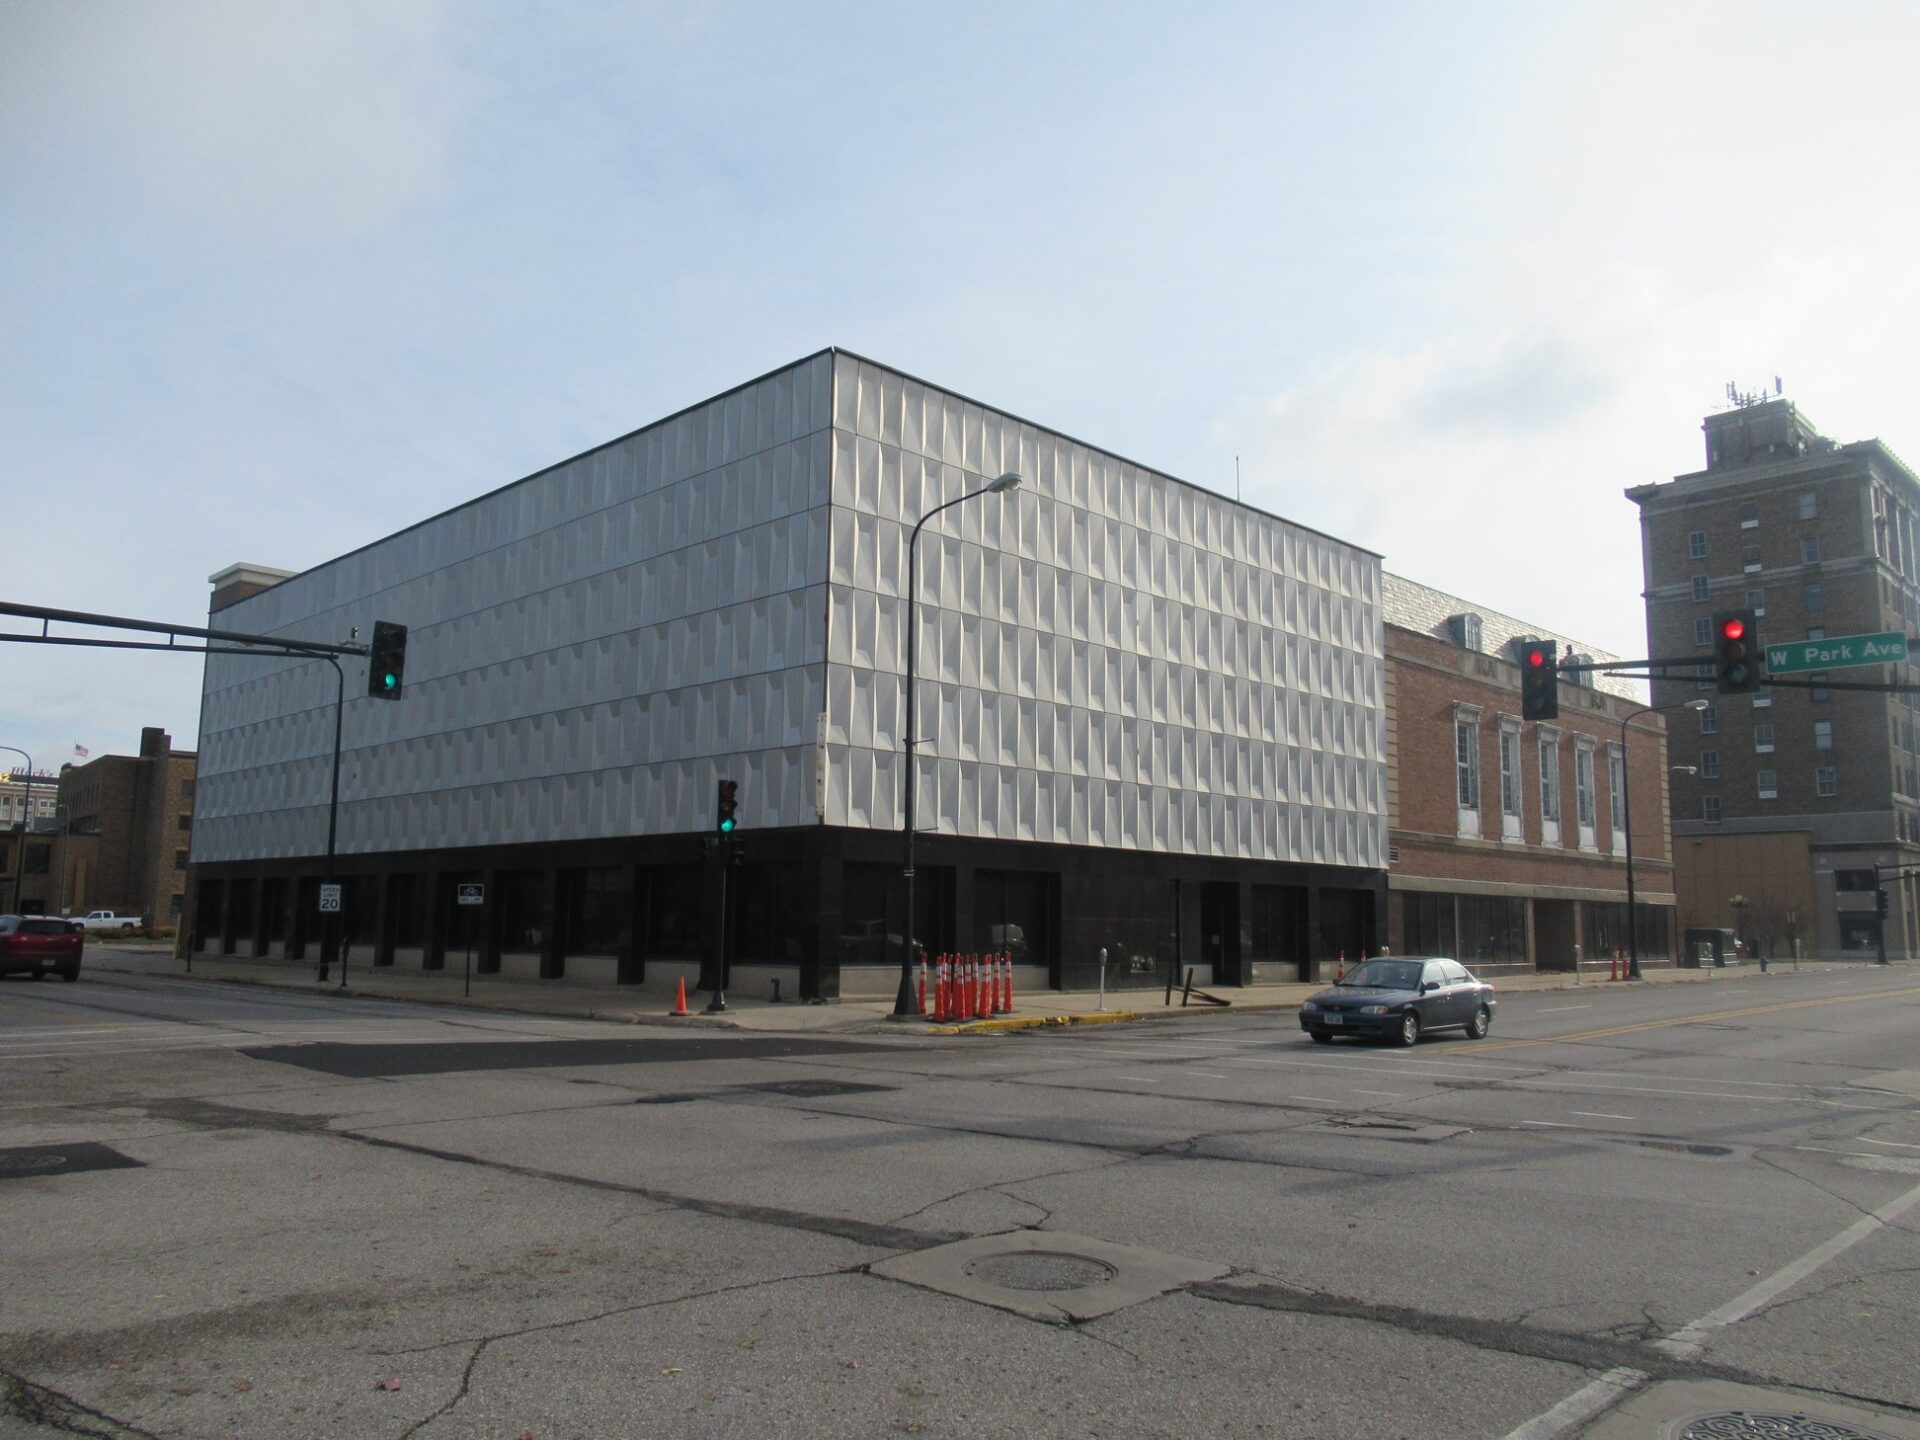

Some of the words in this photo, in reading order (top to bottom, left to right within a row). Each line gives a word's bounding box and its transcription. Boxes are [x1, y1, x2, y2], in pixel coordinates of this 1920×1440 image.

[1770, 651, 1788, 666] W
[1805, 645, 1852, 662] Park
[1863, 642, 1902, 656] Ave
[322, 899, 338, 909] 20
